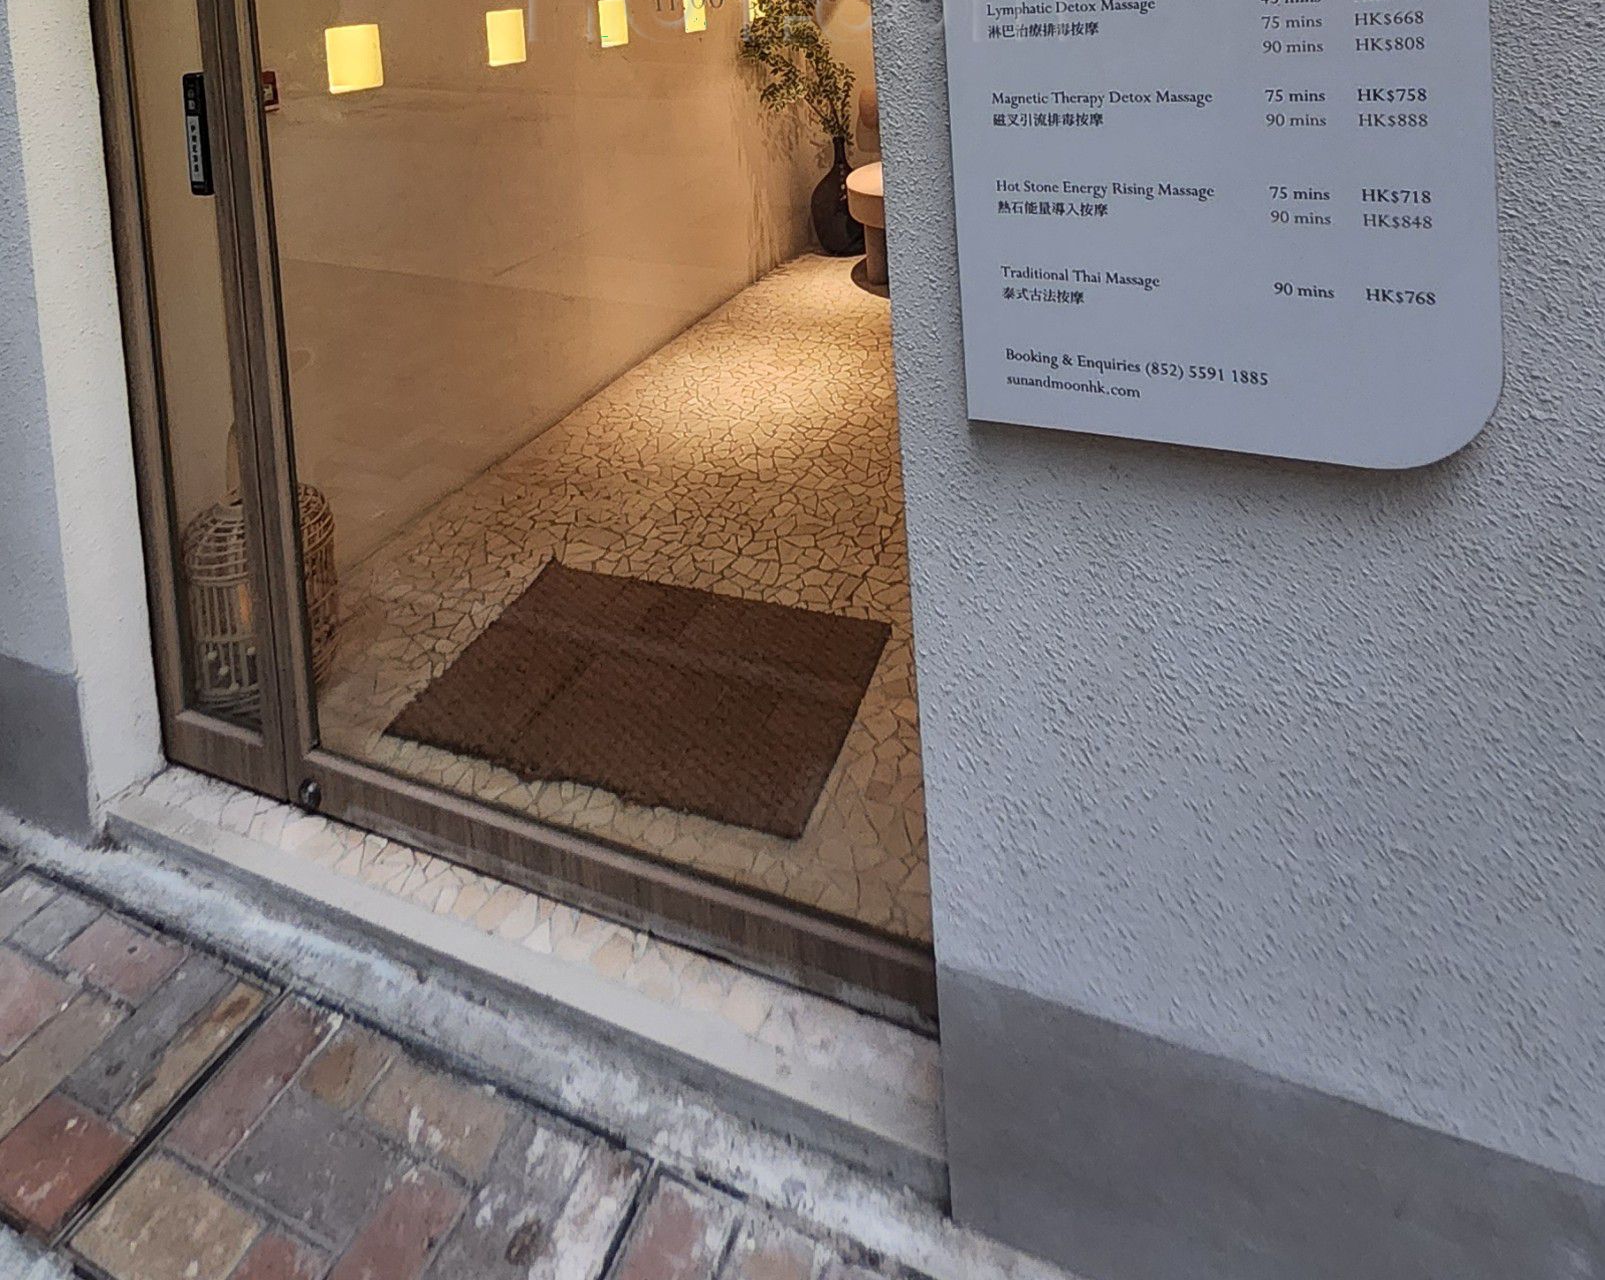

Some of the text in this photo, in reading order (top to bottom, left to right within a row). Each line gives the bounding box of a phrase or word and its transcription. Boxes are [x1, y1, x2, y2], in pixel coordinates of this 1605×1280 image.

[986, 1, 1053, 21] Lymphatic
[1055, 1, 1097, 14] Detox
[1260, 10, 1424, 30] 75 mins HK$668
[1262, 35, 1425, 54] 90 mins HK$808
[991, 90, 1213, 110] Magnetic Therapy Detox Massage
[1264, 87, 1428, 103] 75 mins HK$758
[1265, 113, 1428, 128] 90 mins HK$888
[996, 179, 1215, 203] Hot Stone Energy Rising Massage
[1268, 185, 1432, 204] 75 mins HK$718
[1270, 209, 1433, 230] 90 mins HK$848
[1000, 265, 1160, 292] Traditional Thai Massage
[1002, 287, 1085, 305] 泰式古法按摩
[1273, 281, 1437, 306] 90 mins HK$768
[1005, 347, 1269, 386] Booking & Enquiries (852) 5591 1885
[1006, 375, 1141, 399] sunandmoonhk.com
